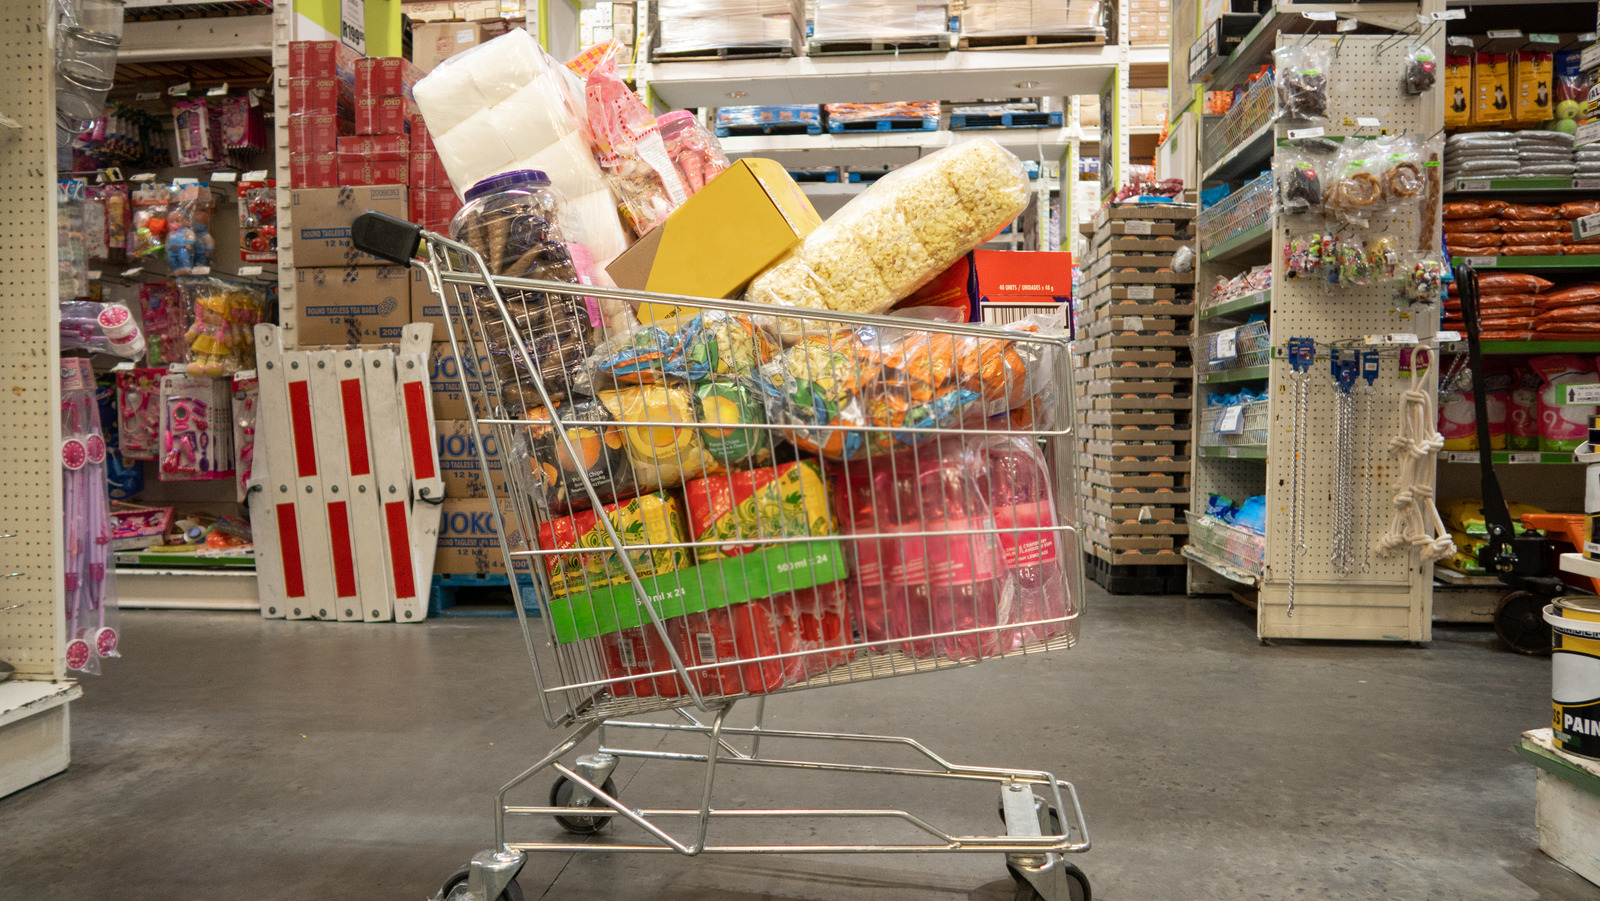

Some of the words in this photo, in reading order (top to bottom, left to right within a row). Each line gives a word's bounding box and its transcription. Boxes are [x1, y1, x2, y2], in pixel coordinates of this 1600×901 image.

[383, 99, 401, 107] JOKO
[339, 239, 350, 248] kg
[307, 307, 326, 315] ROUND
[326, 306, 350, 315] TAGLESS
[350, 306, 361, 314] TEA
[361, 305, 377, 314] BAGS
[431, 356, 495, 380] JOKO
[438, 432, 500, 457] JOKO
[450, 461, 474, 469] TAGLESS
[589, 470, 604, 478] Chips
[468, 471, 480, 480] kg
[440, 512, 506, 535] JOKO
[703, 504, 730, 528] GURANA
[549, 541, 572, 567] GUANA
[1027, 549, 1049, 560] LEMOADE
[777, 562, 794, 573] 500
[795, 559, 807, 568] ml
[816, 554, 828, 564] 24
[636, 596, 653, 606] 50
[674, 588, 686, 597] 24
[1564, 713, 1600, 737] PAIN
